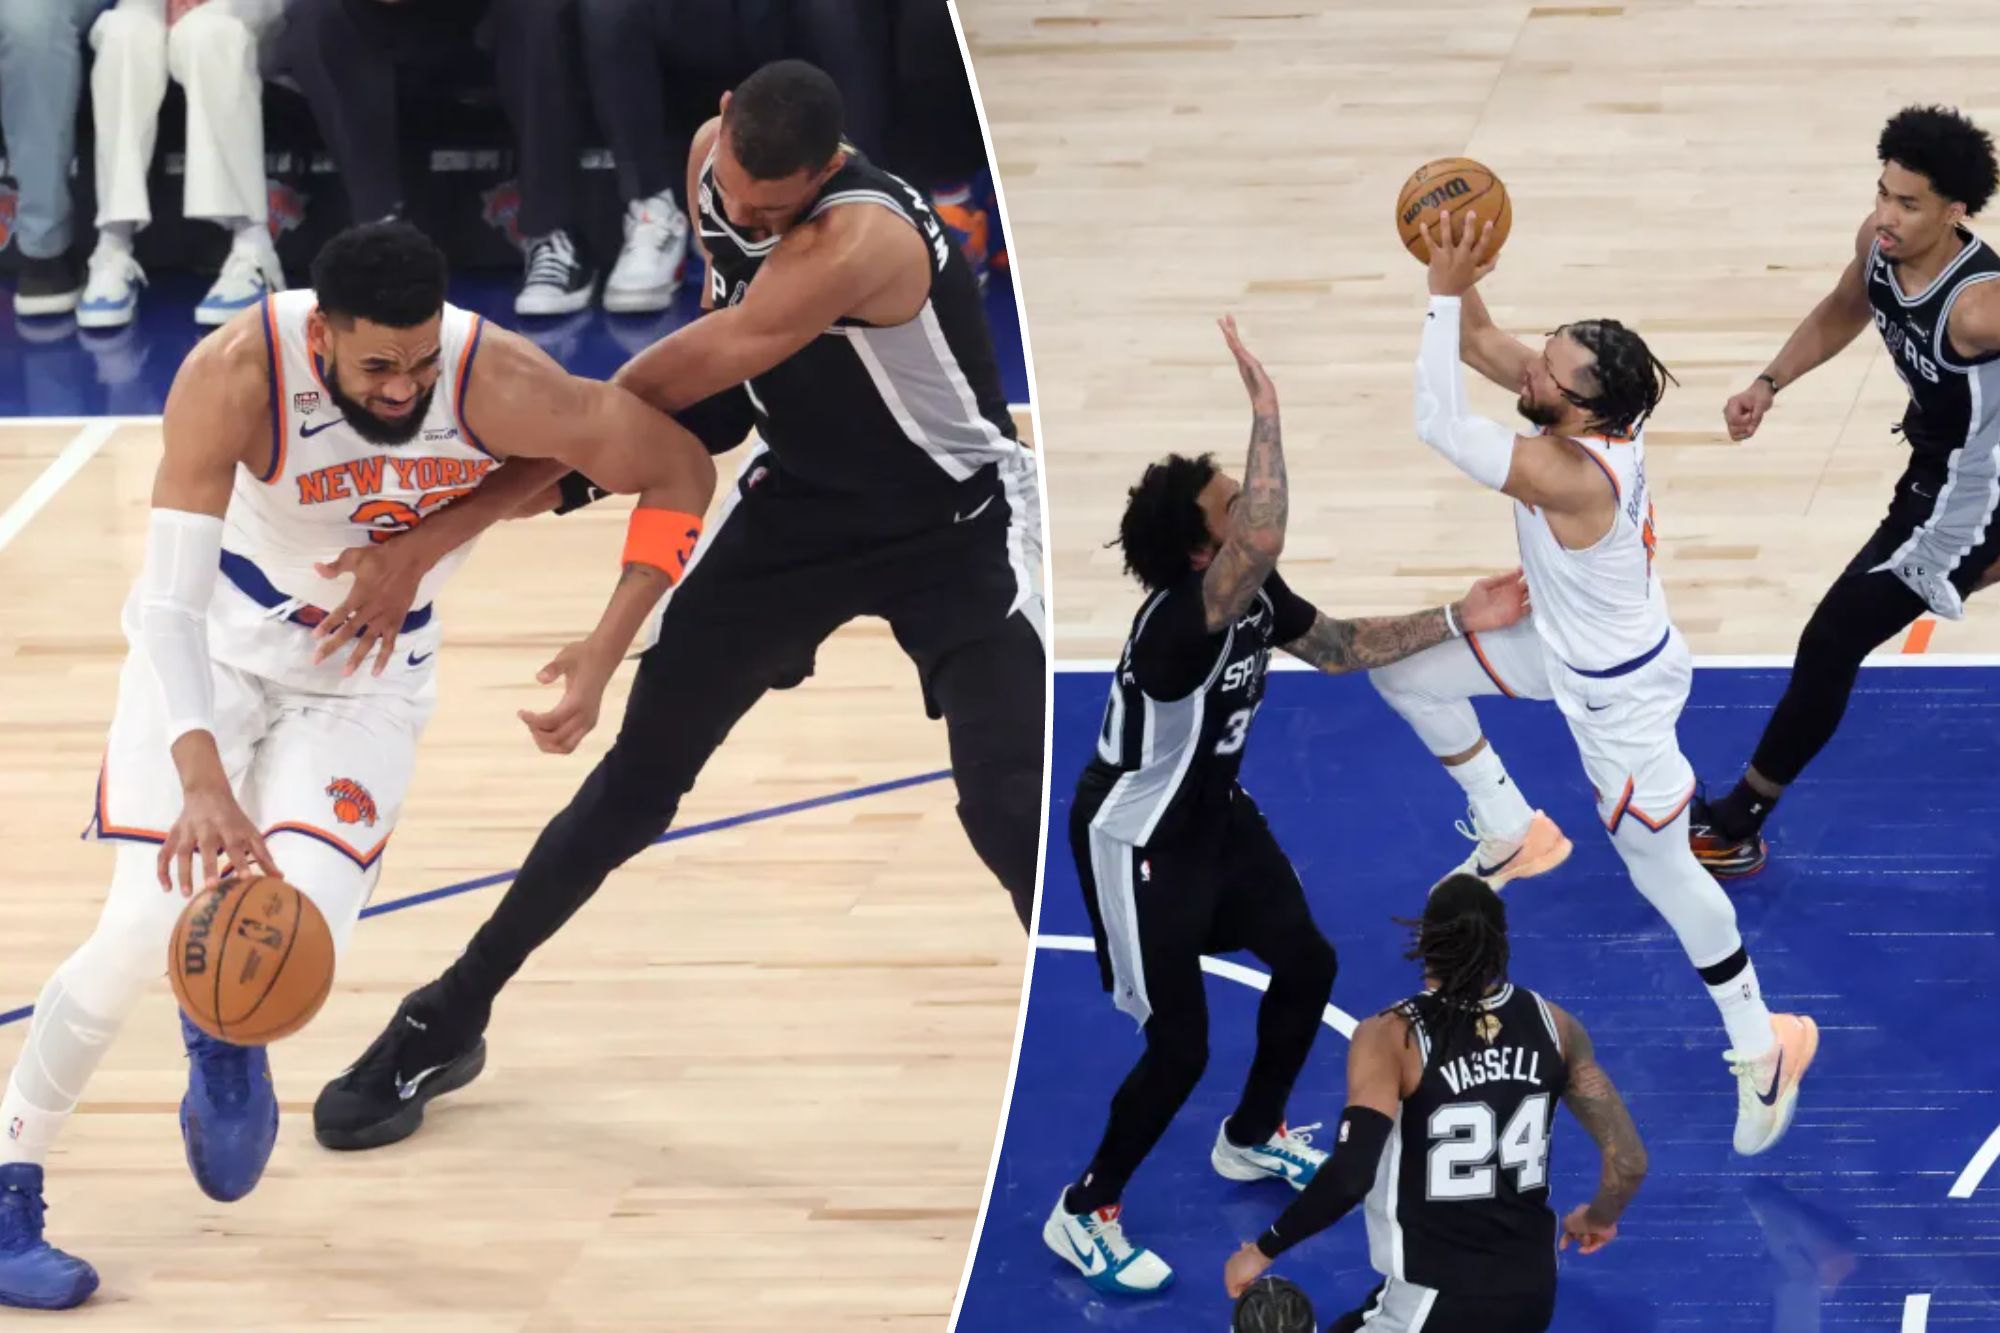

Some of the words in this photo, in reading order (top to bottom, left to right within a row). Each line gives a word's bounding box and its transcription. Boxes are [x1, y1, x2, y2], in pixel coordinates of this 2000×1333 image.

[1403, 177, 1472, 225] Wilson
[296, 455, 387, 505] NEW
[388, 457, 494, 490] YORK
[1438, 1046, 1542, 1096] VASSELL
[1424, 1092, 1550, 1202] 24
